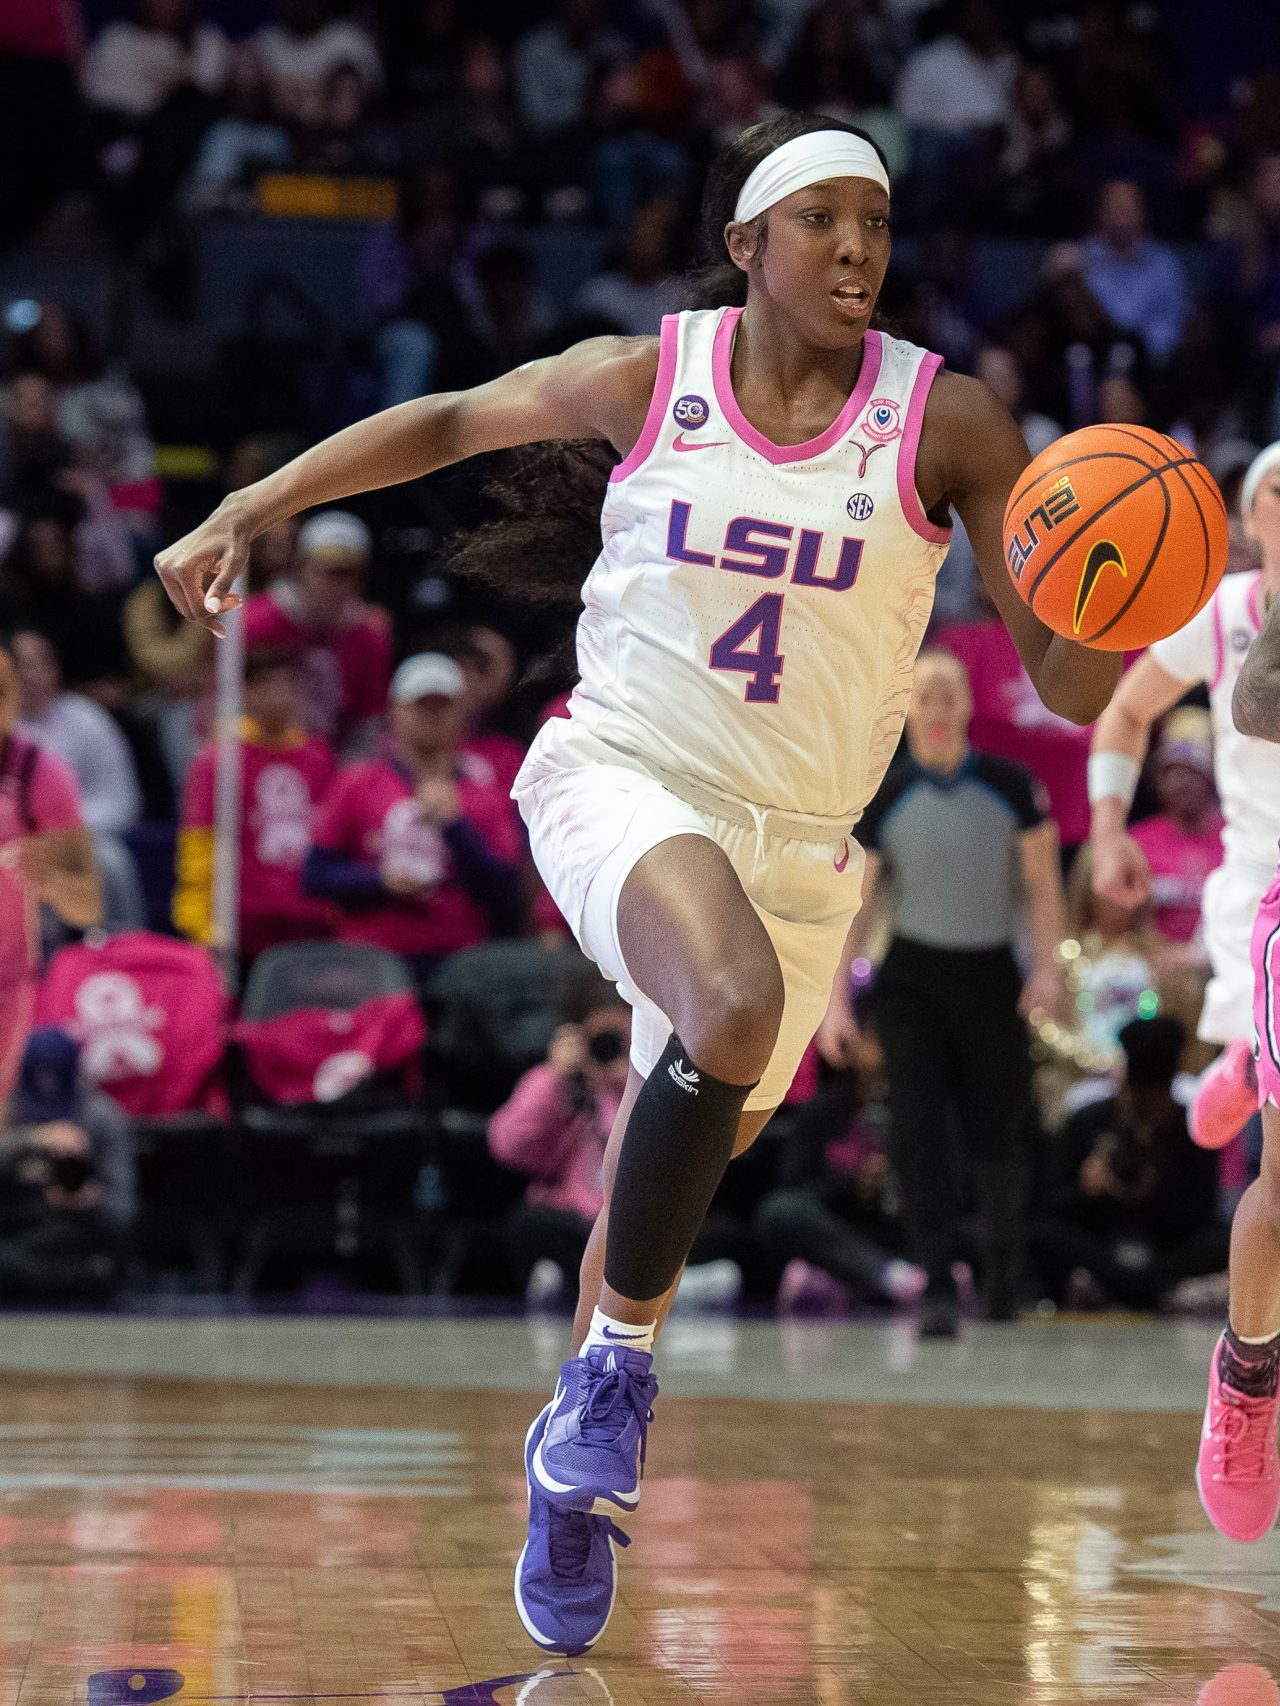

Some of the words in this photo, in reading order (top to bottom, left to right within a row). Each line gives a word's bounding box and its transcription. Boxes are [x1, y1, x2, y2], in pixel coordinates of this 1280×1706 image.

[666, 498, 865, 592] LSU
[847, 493, 873, 520] SEC
[1007, 482, 1081, 583] ELITE
[709, 591, 785, 704] 4
